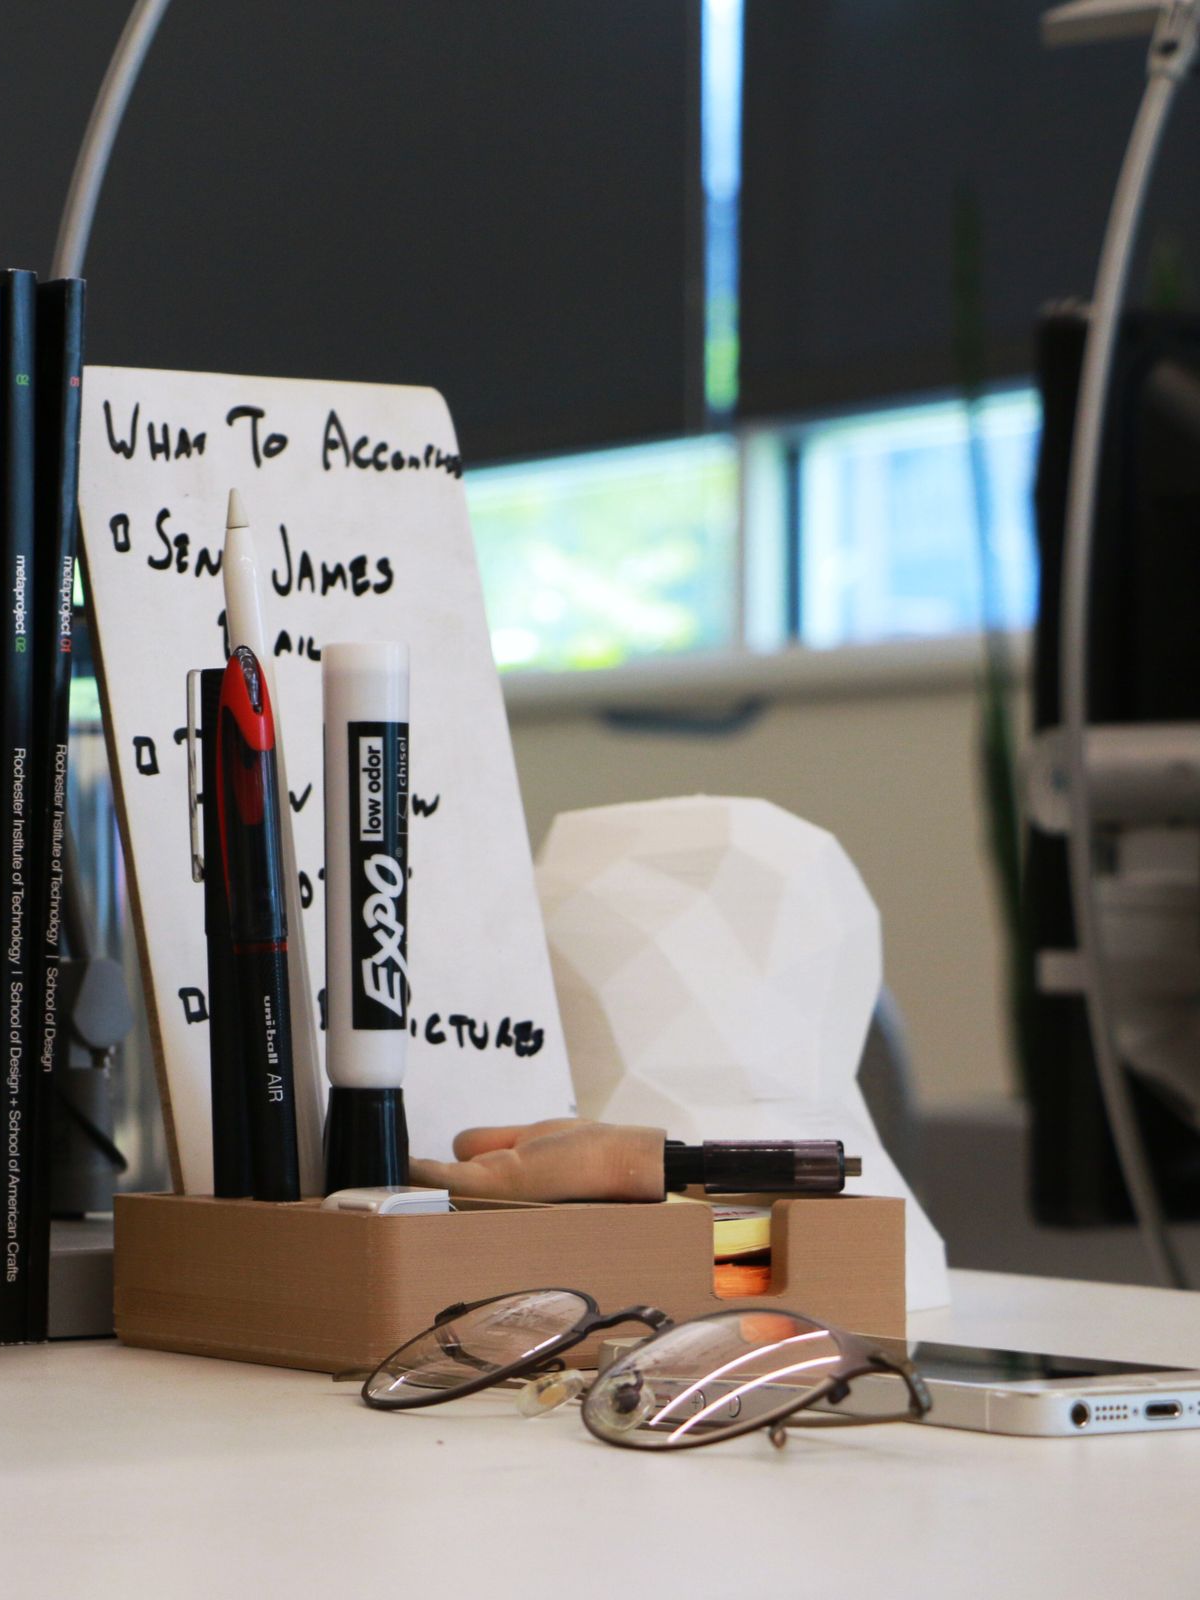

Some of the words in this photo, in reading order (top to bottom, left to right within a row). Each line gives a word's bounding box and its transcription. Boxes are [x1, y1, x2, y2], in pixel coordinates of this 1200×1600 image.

[15, 373, 29, 386] 02
[147, 507, 223, 577] SEN
[13, 555, 27, 635] metaproject
[58, 555, 73, 636] metaproject
[15, 637, 26, 653] 02
[60, 638, 71, 653] 01
[13, 747, 26, 816] Rochester
[53, 744, 67, 808] Rochester
[362, 745, 382, 793] odor
[396, 736, 407, 787] chisel
[52, 811, 65, 858] Institute
[362, 798, 382, 834] low
[12, 819, 25, 870] Institute
[51, 859, 63, 872] of
[12, 872, 24, 886] of
[8, 888, 24, 964] Technology
[46, 875, 63, 945] Technology
[10, 982, 23, 1028] School
[46, 967, 59, 1011] School
[10, 1030, 22, 1043] of
[45, 1012, 56, 1025] of
[407, 978, 545, 1058] ICTURES
[7, 1047, 22, 1094] Design
[41, 1028, 56, 1072] Design
[266, 1073, 283, 1102] AIR
[8, 1110, 21, 1156] School
[8, 1159, 21, 1172] of
[7, 1174, 20, 1239] American
[6, 1241, 19, 1282] Crafts
